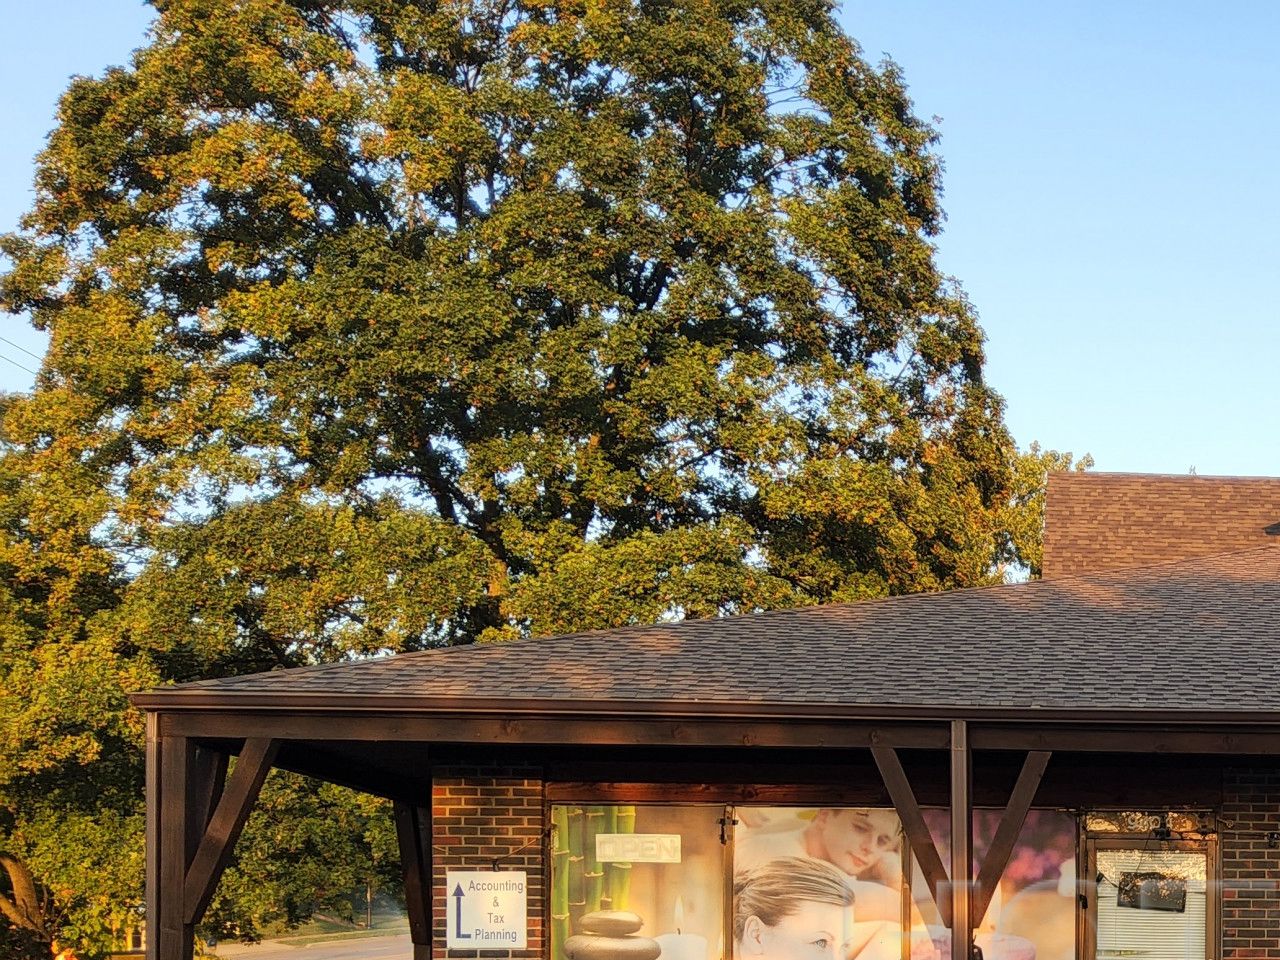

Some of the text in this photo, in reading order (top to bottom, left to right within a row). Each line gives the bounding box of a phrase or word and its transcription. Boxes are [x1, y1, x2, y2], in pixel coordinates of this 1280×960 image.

[468, 879, 524, 893] Accounting
[492, 896, 500, 907] &
[487, 912, 505, 924] Tax
[475, 928, 517, 942] Planning
